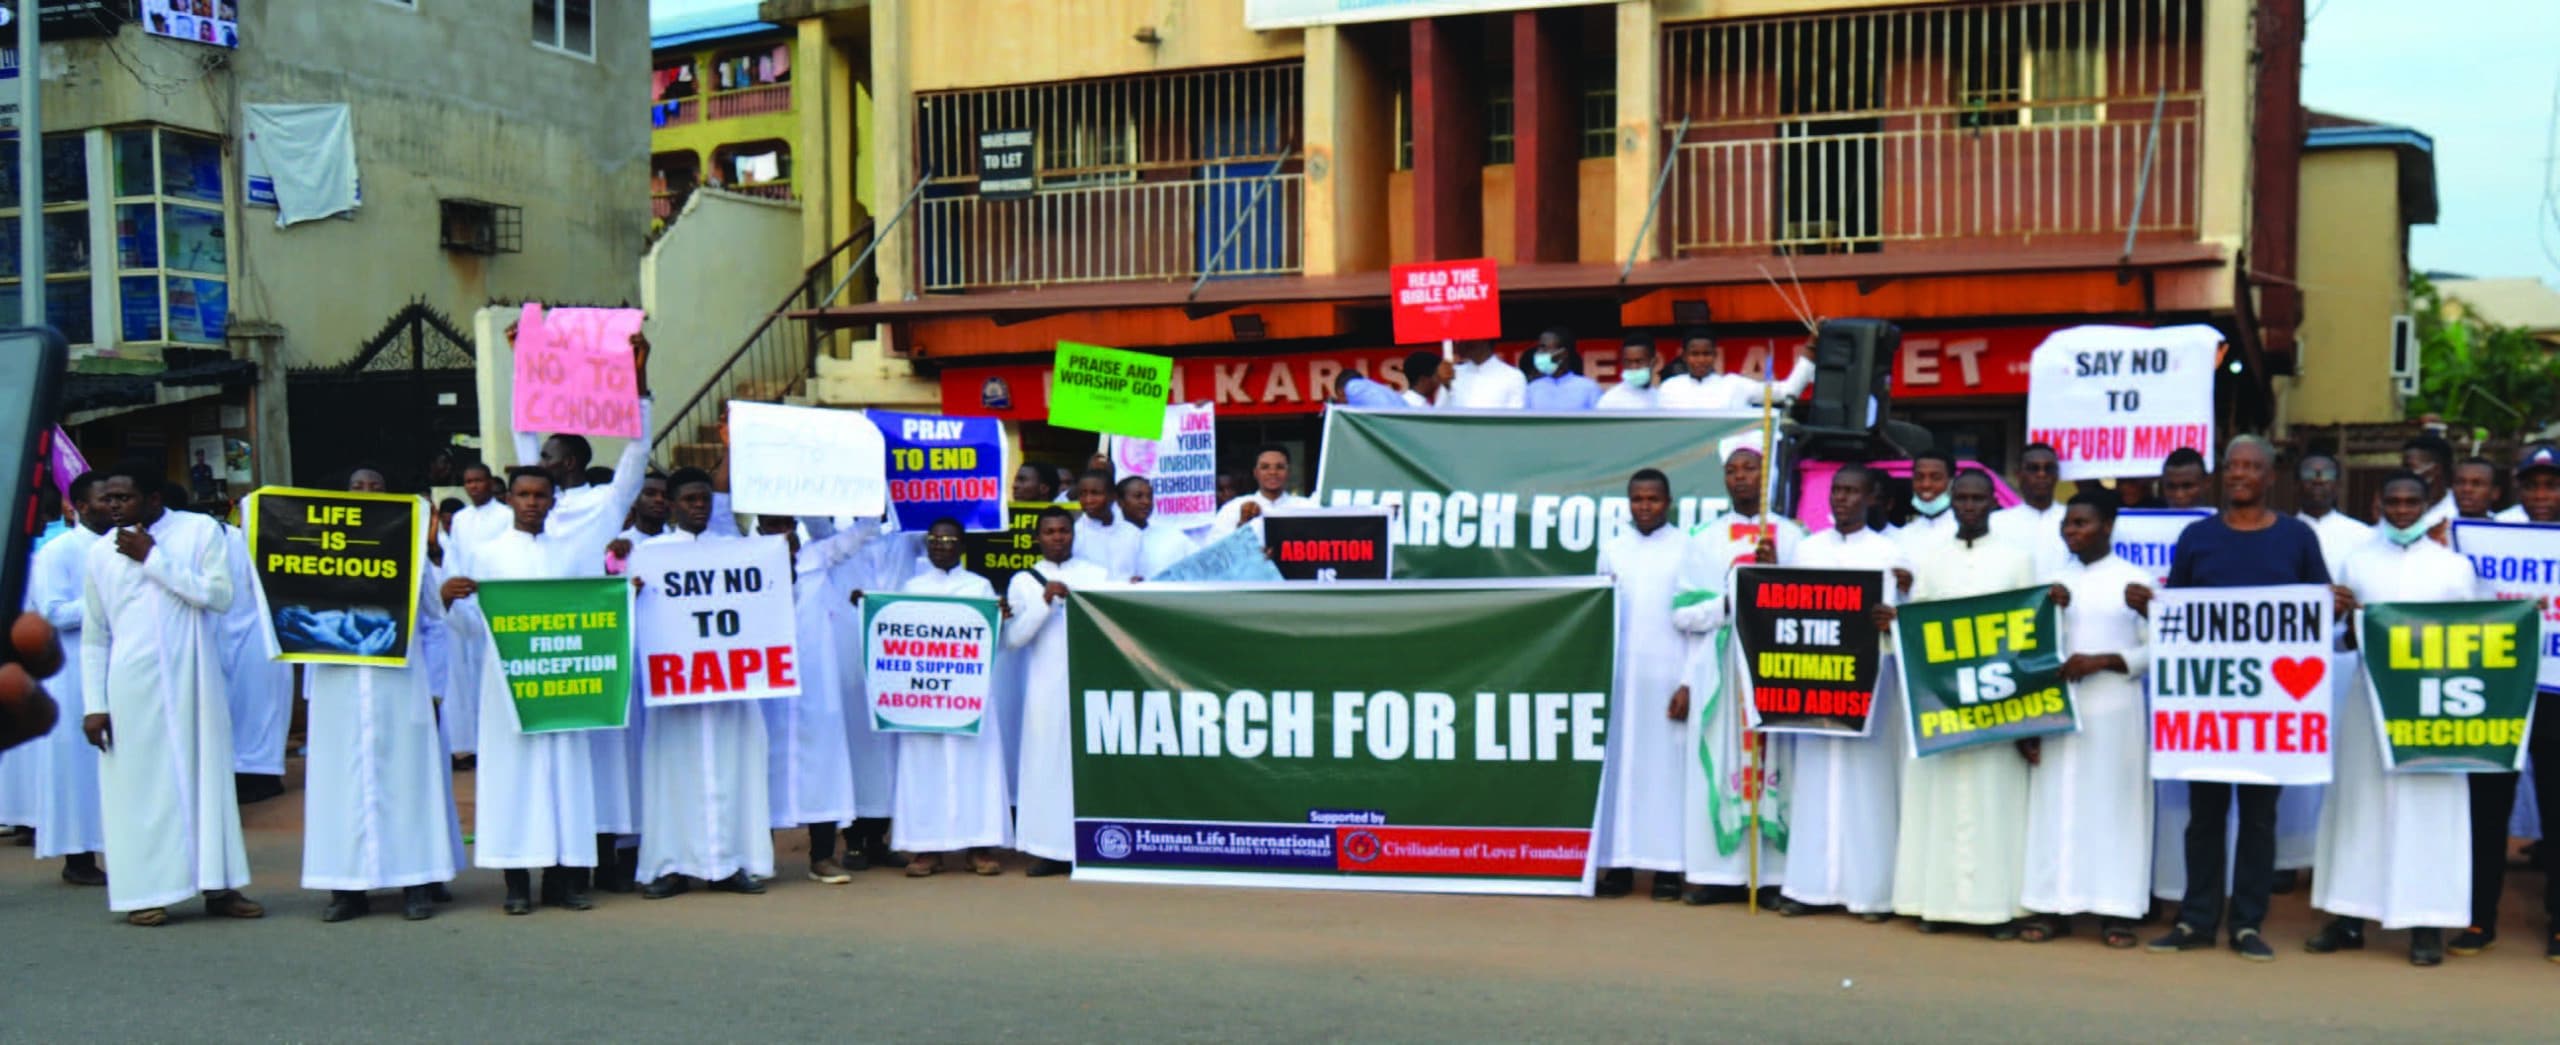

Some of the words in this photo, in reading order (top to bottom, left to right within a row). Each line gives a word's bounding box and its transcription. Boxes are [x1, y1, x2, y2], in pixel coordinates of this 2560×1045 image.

[984, 154, 1000, 170] TO
[1001, 152, 1024, 168] LET
[1408, 270, 1448, 289] READ
[1450, 267, 1480, 285] THE
[1400, 286, 1444, 306] BIBLE
[1446, 283, 1489, 303] DAILY
[525, 351, 565, 386] NO
[585, 356, 628, 392] TO
[1069, 355, 1122, 376] PRAISE
[1126, 362, 1158, 382] AND
[2076, 349, 2123, 378] SAY
[2132, 348, 2168, 375] NO
[1060, 369, 1128, 392] WORSHIP
[1132, 380, 1163, 399] GOD
[2106, 390, 2141, 412] TO
[526, 392, 637, 435] CONDOM
[1180, 411, 1211, 432] LOVE
[902, 417, 964, 441] PRAY
[2133, 422, 2208, 459] MMIRI
[1176, 433, 1212, 452] YOUR
[891, 447, 925, 471] TO
[929, 446, 978, 470] END
[1159, 453, 1212, 473] UNBORN
[889, 476, 999, 503] BORTION
[307, 504, 363, 526] LIFE
[1155, 494, 1216, 514] YOURSELF
[321, 530, 347, 550] IS
[1013, 533, 1033, 549] IS
[1281, 539, 1374, 562] ABORTION
[268, 553, 398, 579] PRECIOUS
[984, 552, 1044, 570] SACR
[663, 568, 716, 598] SAY
[724, 565, 763, 594] NO
[1316, 567, 1338, 584] IS
[1755, 582, 1863, 612] ABORTION
[491, 612, 578, 634] RESPECT
[581, 610, 618, 630] LIFE
[691, 608, 741, 638] TO
[877, 622, 985, 641] PREGNANT
[1775, 617, 1799, 645] IS
[1801, 618, 1841, 647] THE
[2159, 601, 2322, 644] #UNBORN
[529, 634, 584, 654] FROM
[1922, 607, 2037, 664] LIFE
[2388, 623, 2518, 671] LIFE
[883, 639, 980, 660] WOMEN
[647, 644, 797, 698] RAPE
[875, 657, 912, 673] NEED
[915, 660, 984, 676] SUPPORT
[1758, 651, 1857, 682] ULTIMATE
[2156, 657, 2263, 699] LIVES
[512, 681, 539, 700] TO
[543, 676, 603, 698] DEATH
[910, 677, 953, 692] NOT
[1956, 661, 2017, 704] IS
[876, 691, 983, 712] ABORTION
[1755, 686, 1801, 713] HILD
[1803, 689, 1873, 718] ABUSE
[2418, 675, 2487, 718] IS
[1919, 686, 2065, 739] PRECIOUS
[1083, 688, 1315, 759] MARCH
[1333, 690, 1456, 761] FOR
[1474, 692, 1606, 762] LIFE
[2153, 710, 2328, 754] MATTER
[1309, 810, 1369, 825] Supported
[1371, 811, 1386, 826] by
[1135, 829, 1193, 845] Human
[1196, 831, 1226, 846] Life
[1229, 832, 1332, 848] International
[1293, 847, 1332, 858] WORLD
[1382, 842, 1461, 859] Civilisation
[1463, 843, 1479, 859] of
[1481, 844, 1517, 860] Love
[1519, 845, 1588, 860] Foundatio
